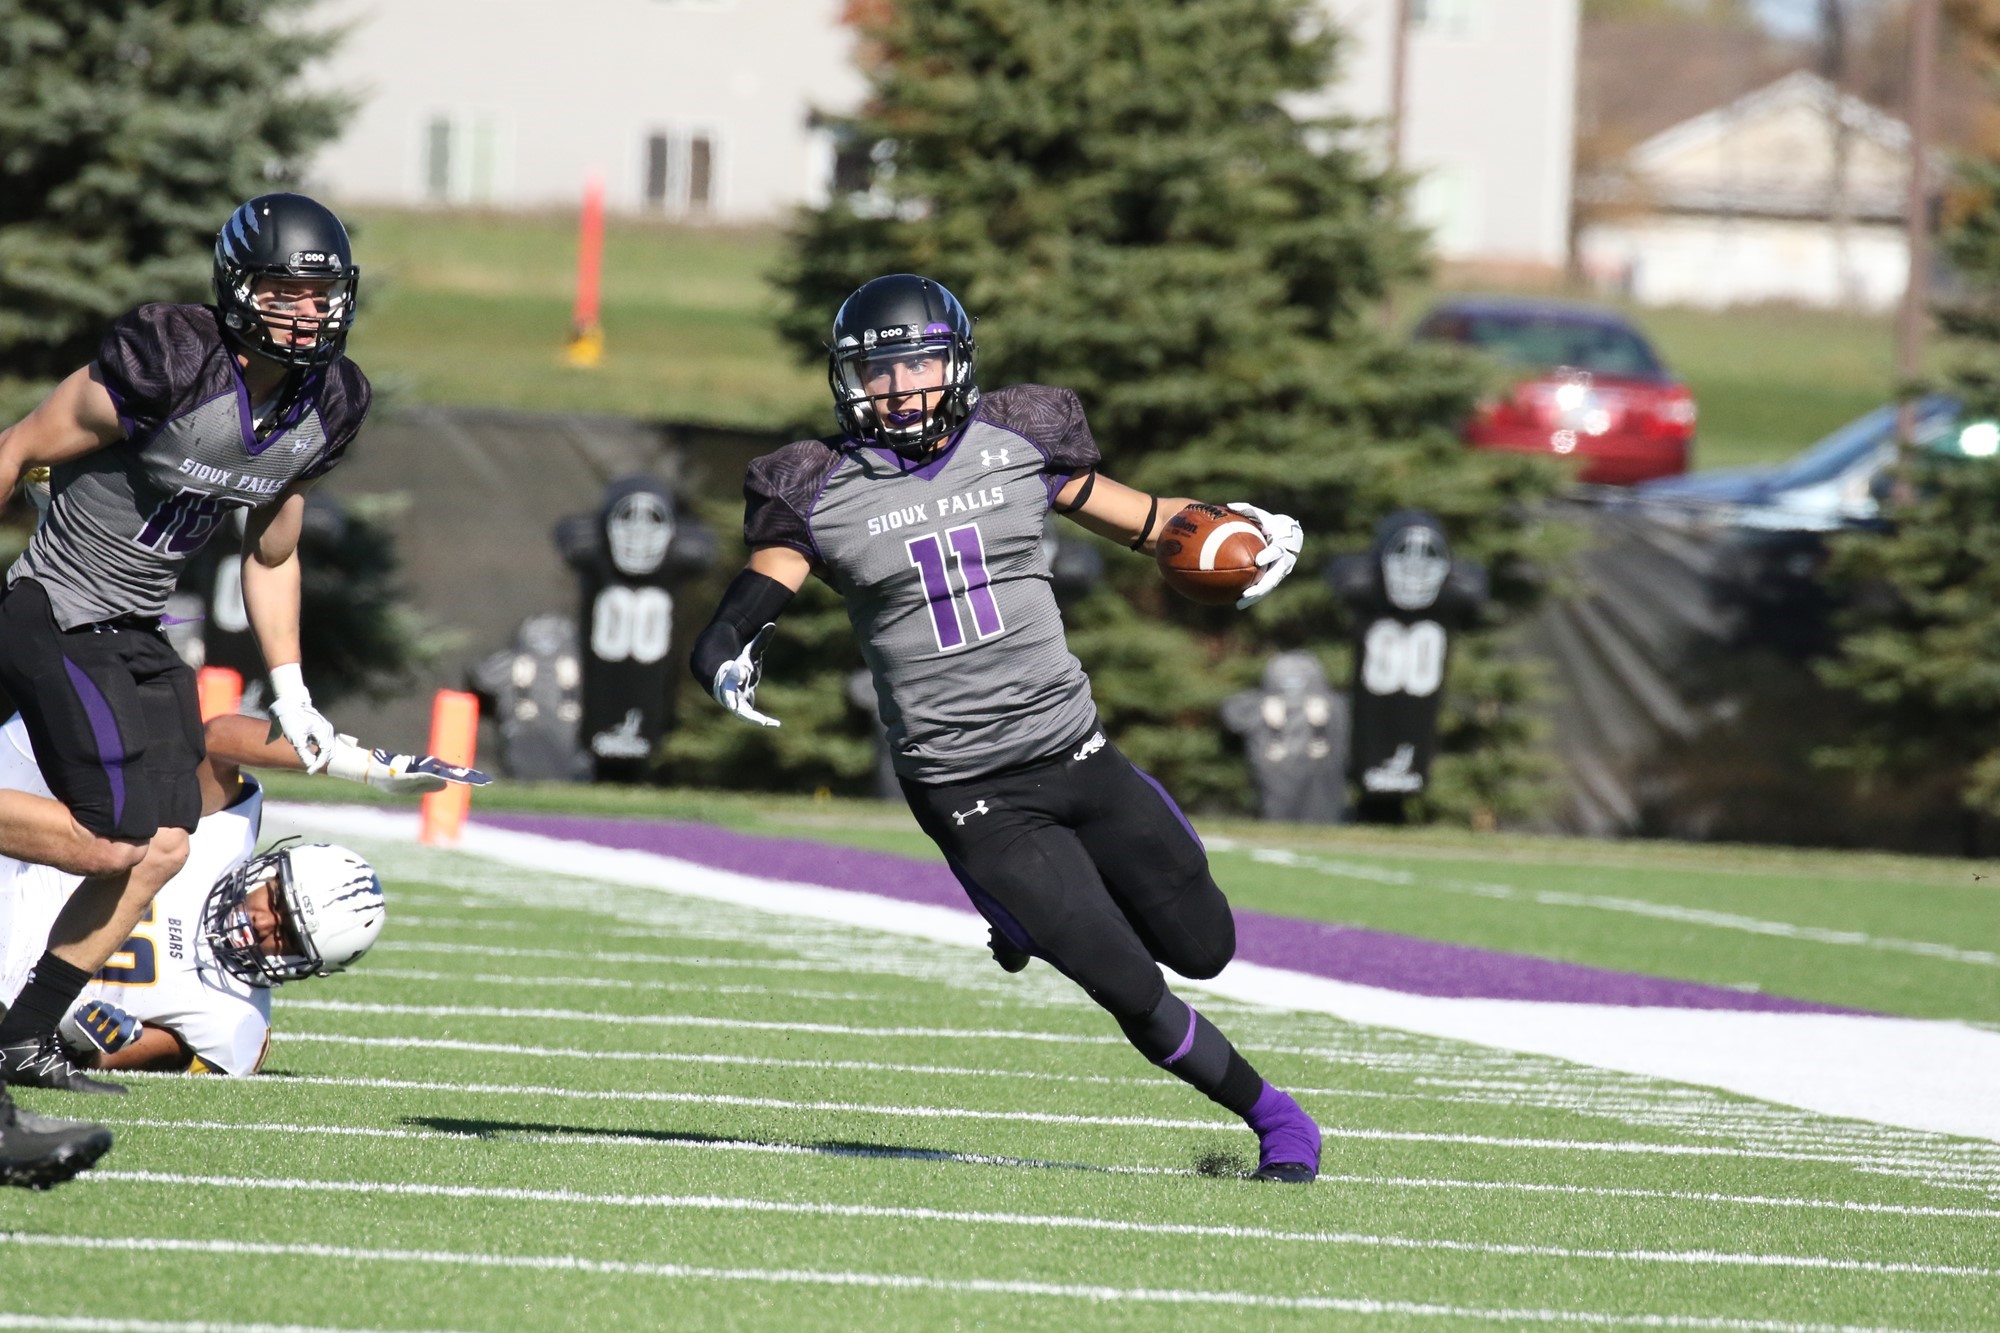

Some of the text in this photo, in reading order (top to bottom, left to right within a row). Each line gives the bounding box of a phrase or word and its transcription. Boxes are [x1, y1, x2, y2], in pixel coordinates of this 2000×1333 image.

[178, 458, 288, 494] SIOUX FALLS
[867, 486, 1005, 536] SIOUX FALLS
[904, 522, 1005, 652] 11
[592, 586, 673, 664] 00
[168, 917, 184, 959] BEARS
